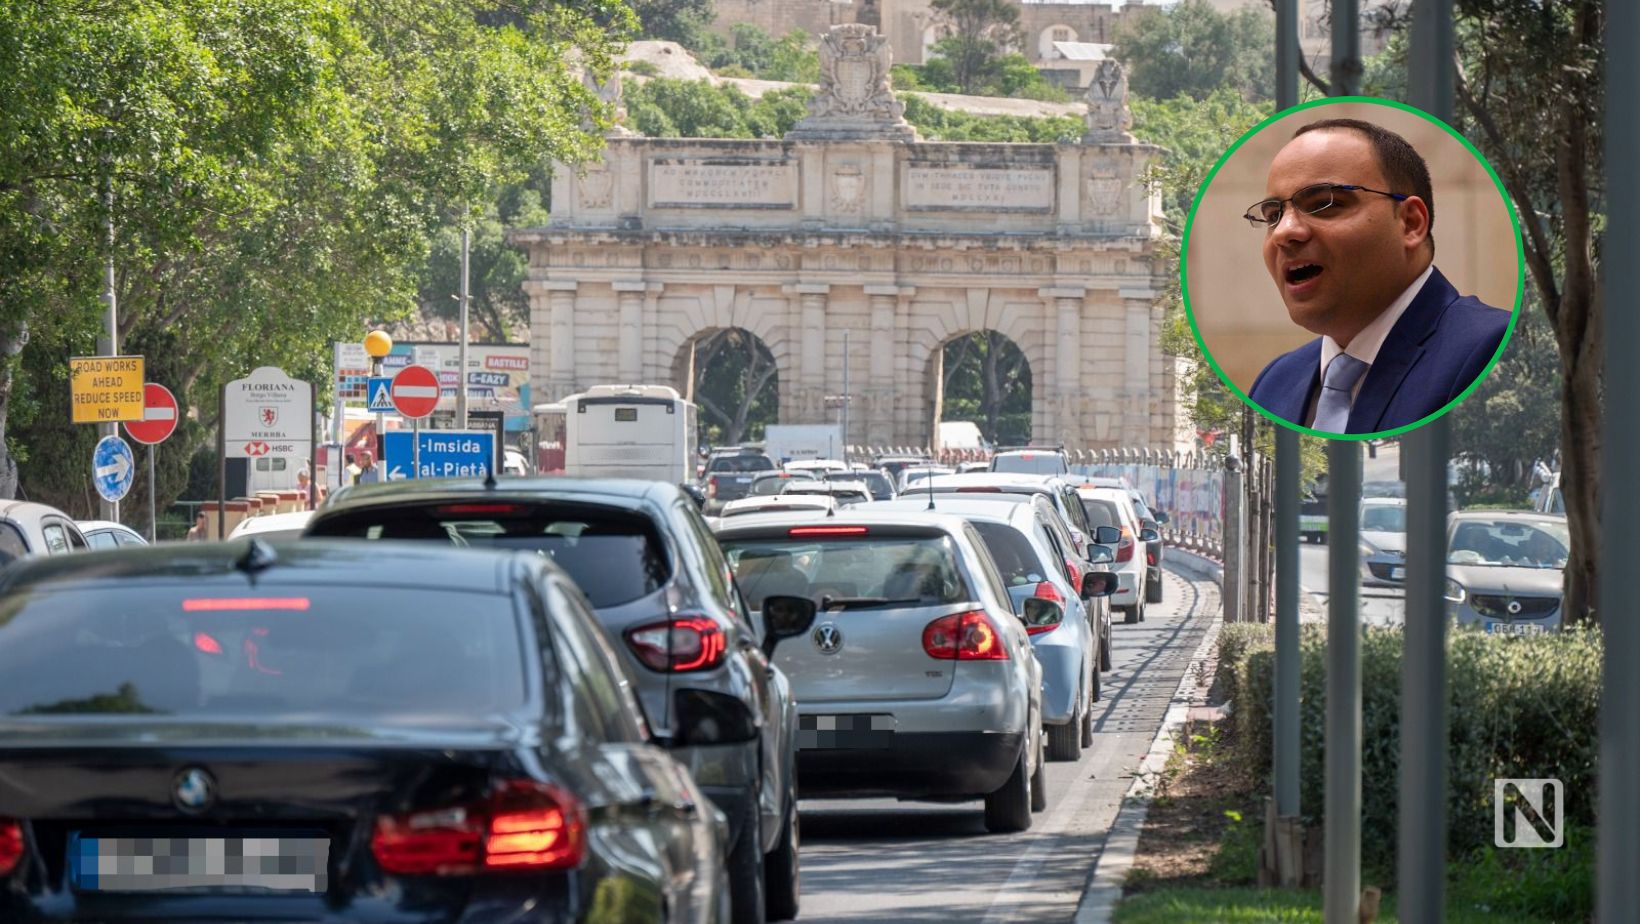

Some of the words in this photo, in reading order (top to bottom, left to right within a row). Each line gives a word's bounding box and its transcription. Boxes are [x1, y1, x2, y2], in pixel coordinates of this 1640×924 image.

[76, 361, 102, 373] ROAD
[104, 360, 137, 372] WORKS
[488, 358, 528, 369] BASTILLE
[92, 376, 123, 388] AHEAD
[469, 373, 506, 385] G-EAZY
[242, 383, 295, 391] FLORIANA
[74, 392, 111, 404] REDUCE
[113, 391, 142, 403] SPEED
[98, 407, 119, 419] NOW
[414, 438, 481, 453] -Imsida
